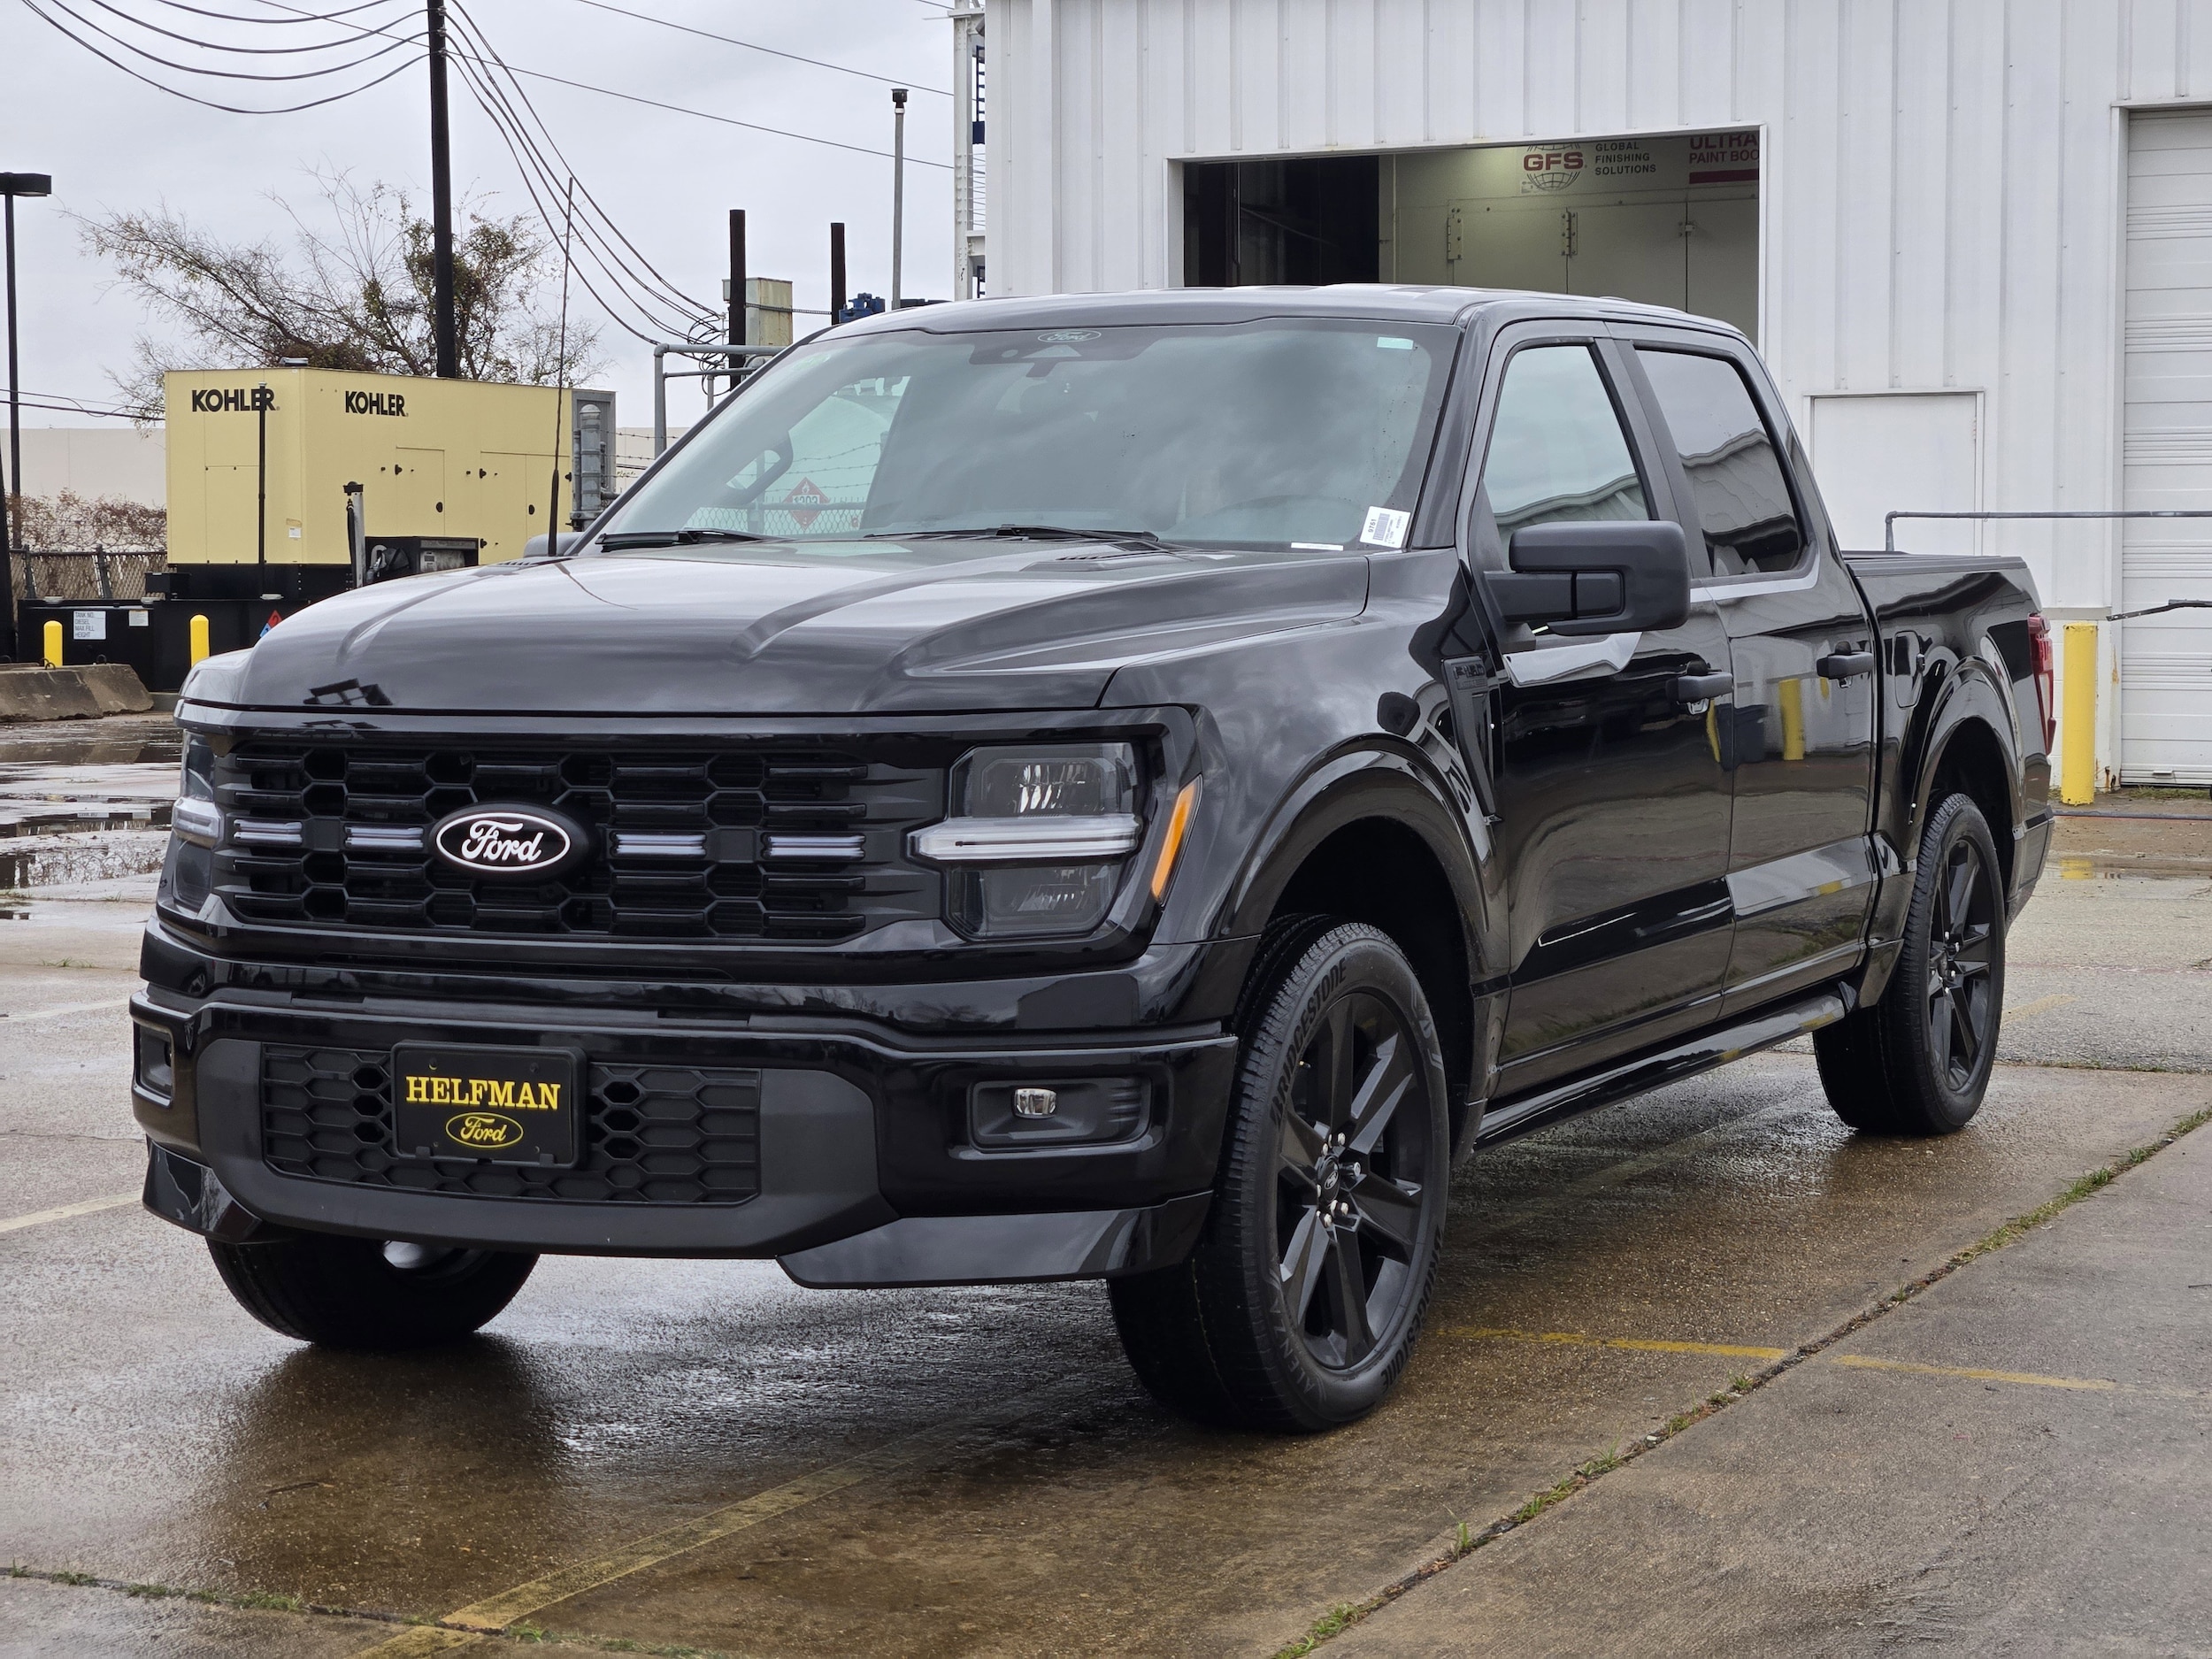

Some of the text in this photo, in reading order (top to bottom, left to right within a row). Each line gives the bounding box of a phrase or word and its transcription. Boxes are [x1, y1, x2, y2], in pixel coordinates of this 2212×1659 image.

[1594, 152, 1650, 164] FINISHING
[1595, 142, 1640, 152] GLOBAL
[1689, 150, 1728, 165] PAINT
[1524, 151, 1584, 172] GFS
[1594, 164, 1656, 176] SOLUTIONS
[191, 388, 276, 412] KOHLER
[344, 390, 406, 417] KOHLER
[461, 819, 544, 862] Ford
[1269, 956, 1348, 1130] BRIDGESTONE
[405, 1075, 563, 1111] HELFMAN
[460, 1115, 508, 1142] Ford
